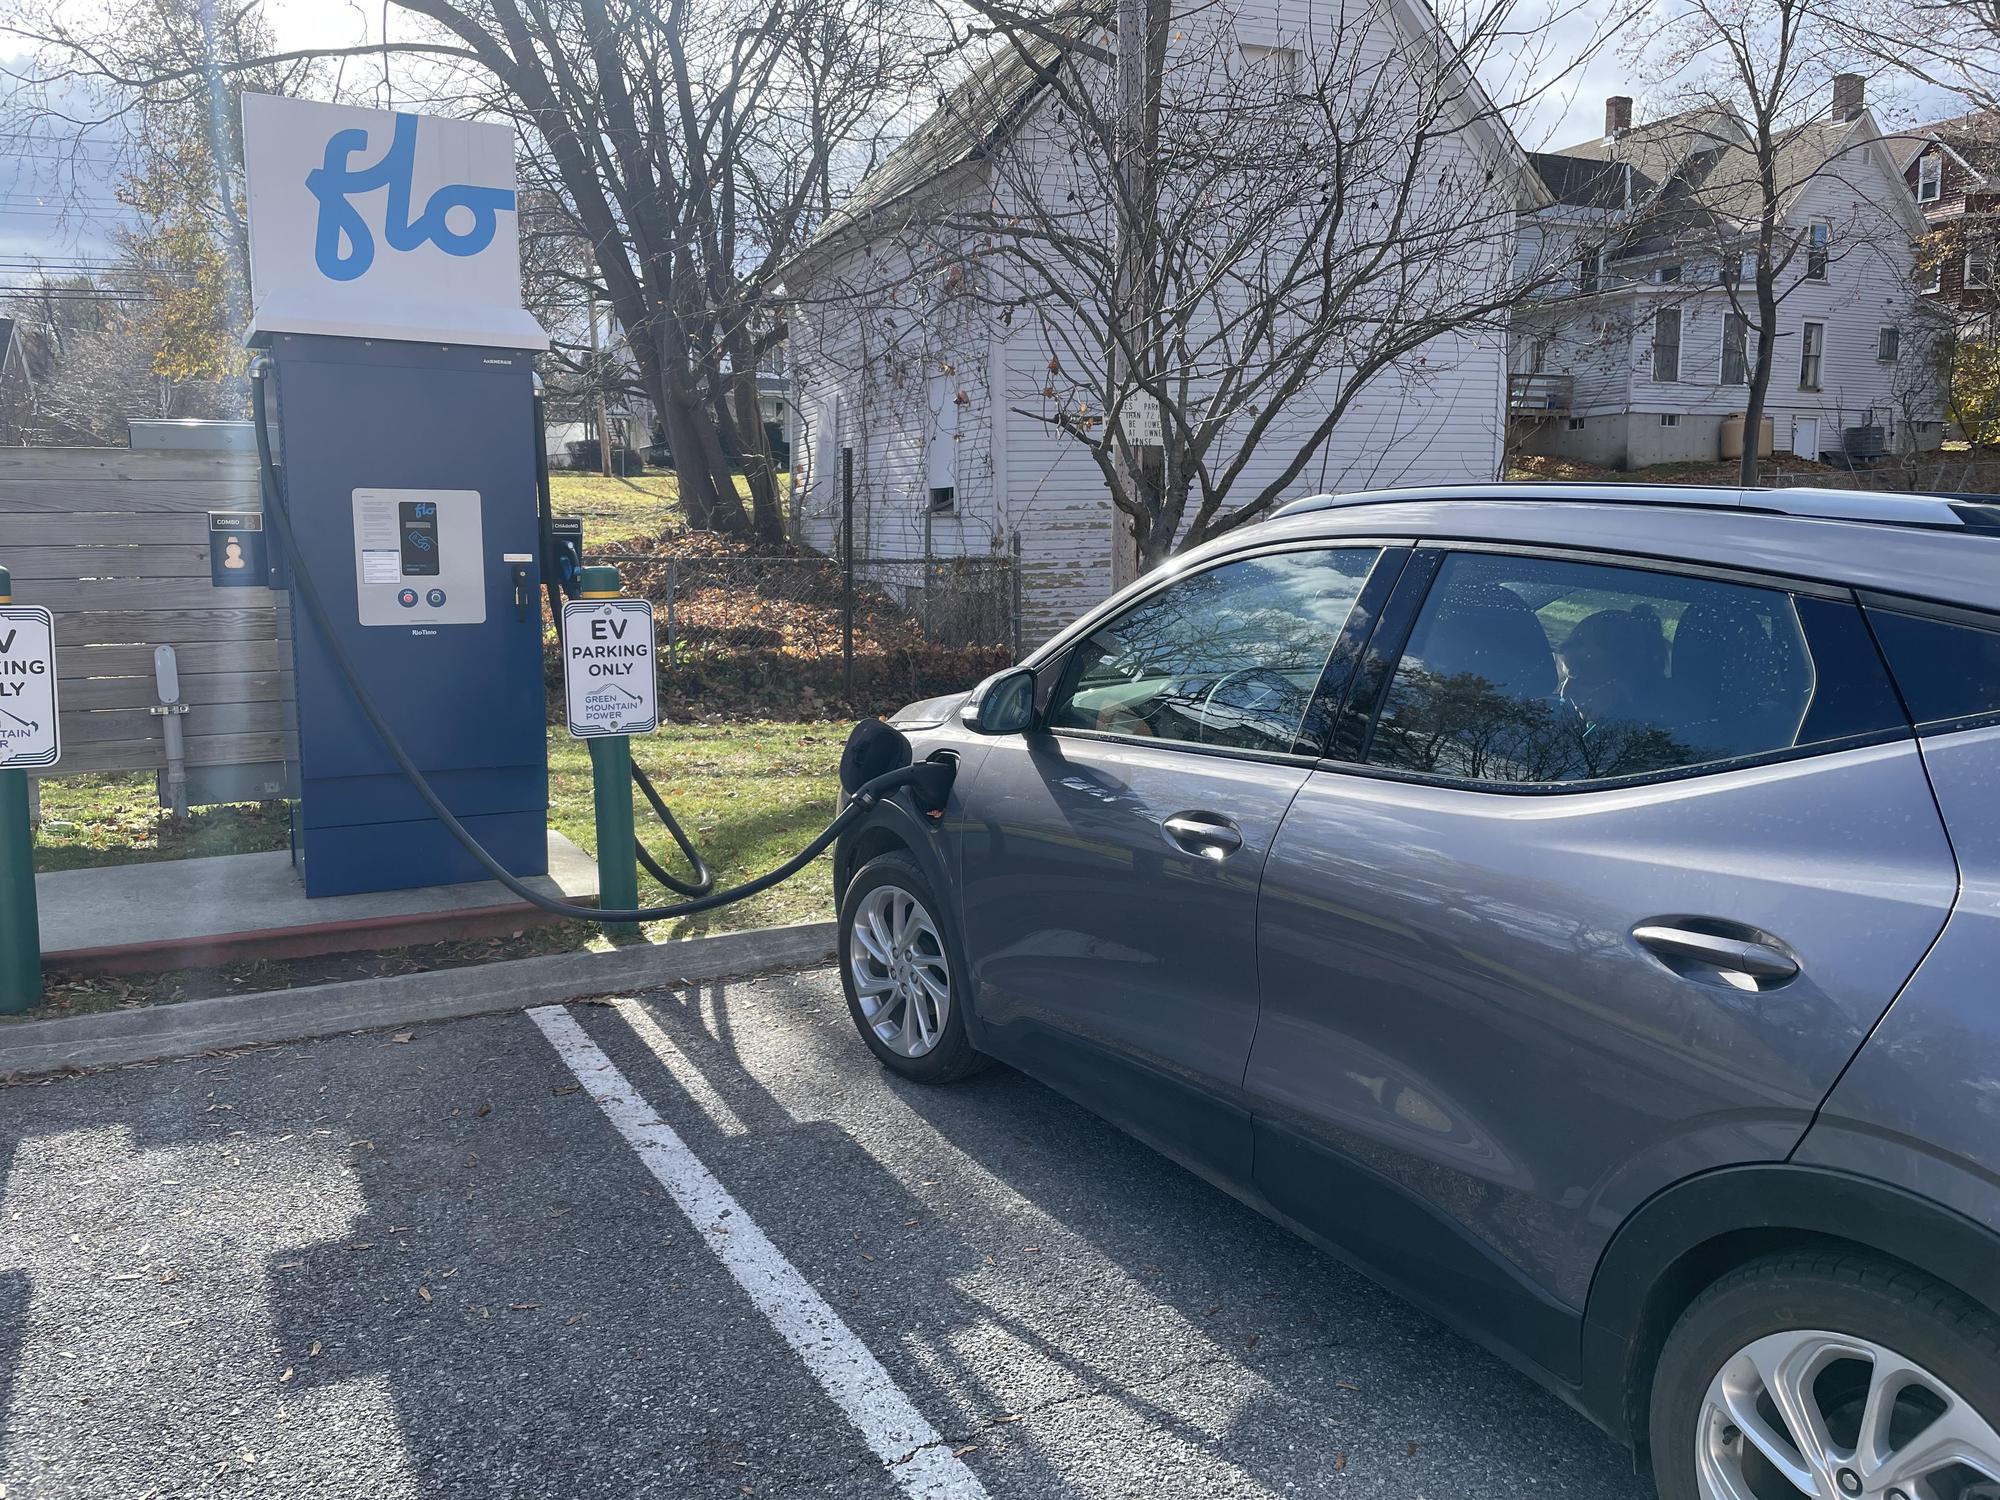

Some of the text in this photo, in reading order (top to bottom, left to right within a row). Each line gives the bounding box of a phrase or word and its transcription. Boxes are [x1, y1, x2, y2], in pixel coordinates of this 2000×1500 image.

[305, 112, 515, 281] flo
[591, 618, 628, 640] EV
[572, 644, 648, 659] PARKING
[0, 660, 45, 675] ING
[588, 662, 634, 677] ONLY
[585, 695, 617, 704] GREEN
[585, 702, 638, 712] MOUNTAIN
[586, 711, 622, 721] POWER
